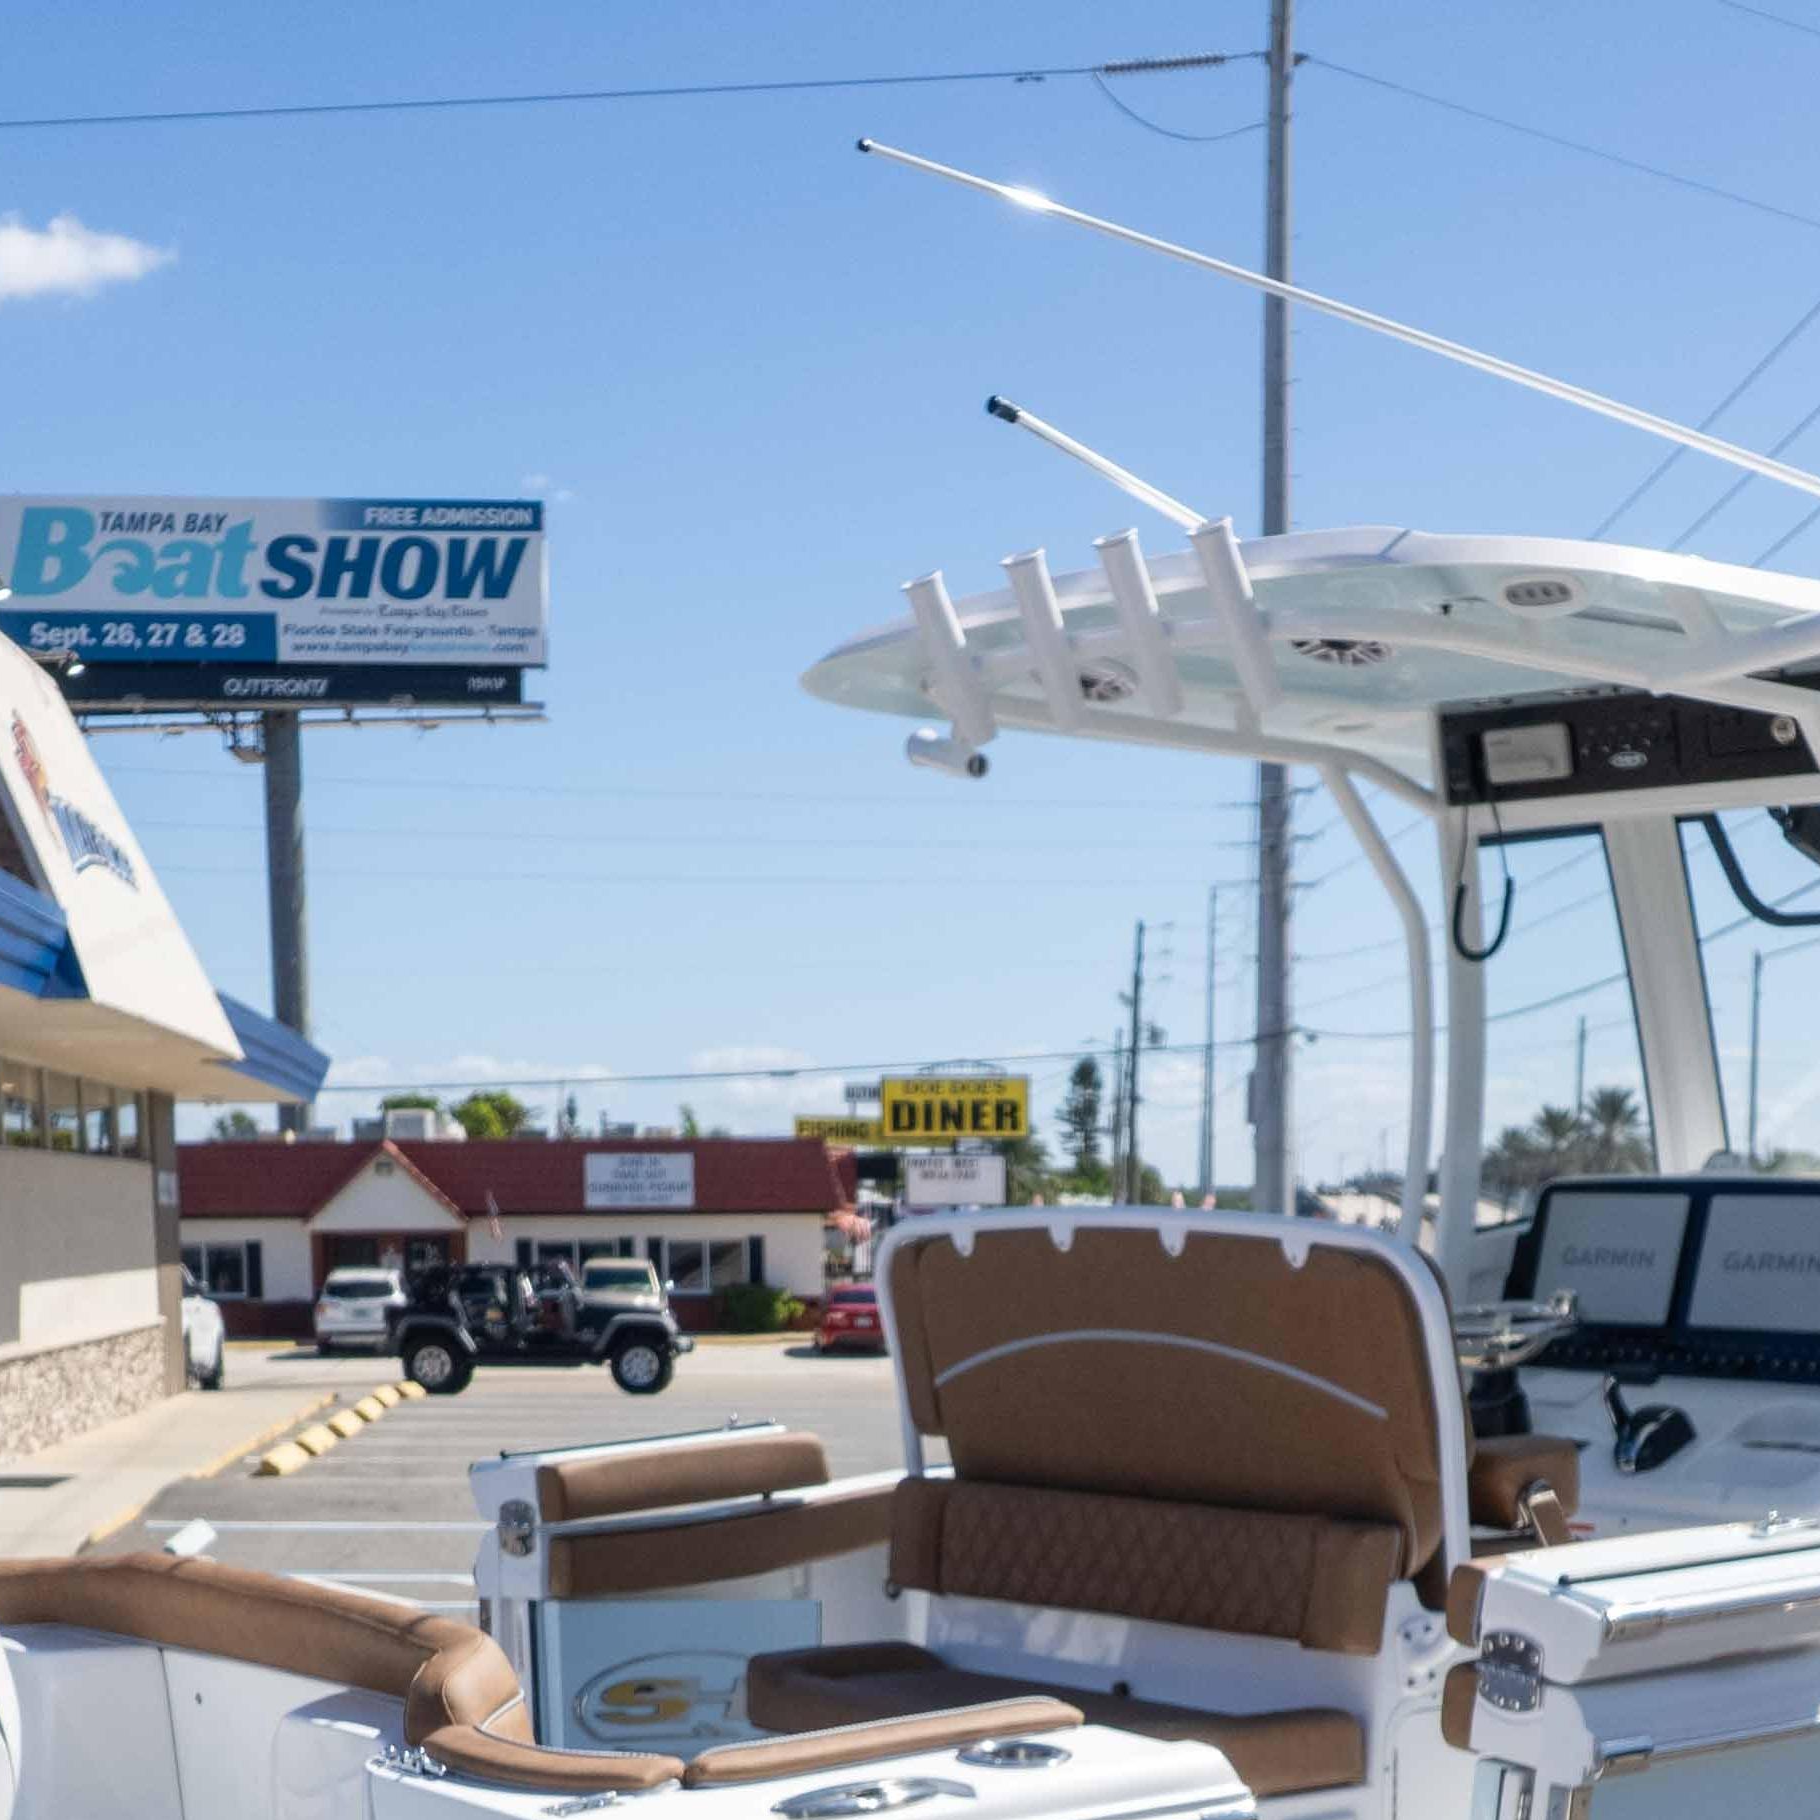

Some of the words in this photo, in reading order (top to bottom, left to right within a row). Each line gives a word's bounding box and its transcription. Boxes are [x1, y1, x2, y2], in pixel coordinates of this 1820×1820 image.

[99, 511, 176, 534] TAMPA
[181, 512, 228, 534] BAY
[364, 506, 416, 526] FREE
[420, 506, 533, 527] ADMISSION
[9, 506, 259, 599] Boat
[258, 534, 530, 600] SHOW
[30, 622, 97, 651] Sept.
[101, 621, 143, 650] 26,
[146, 622, 180, 648] 27
[184, 622, 208, 648] &
[212, 622, 247, 648] 28
[891, 1099, 1019, 1132] DINER
[1561, 1246, 1656, 1268] GARMIN
